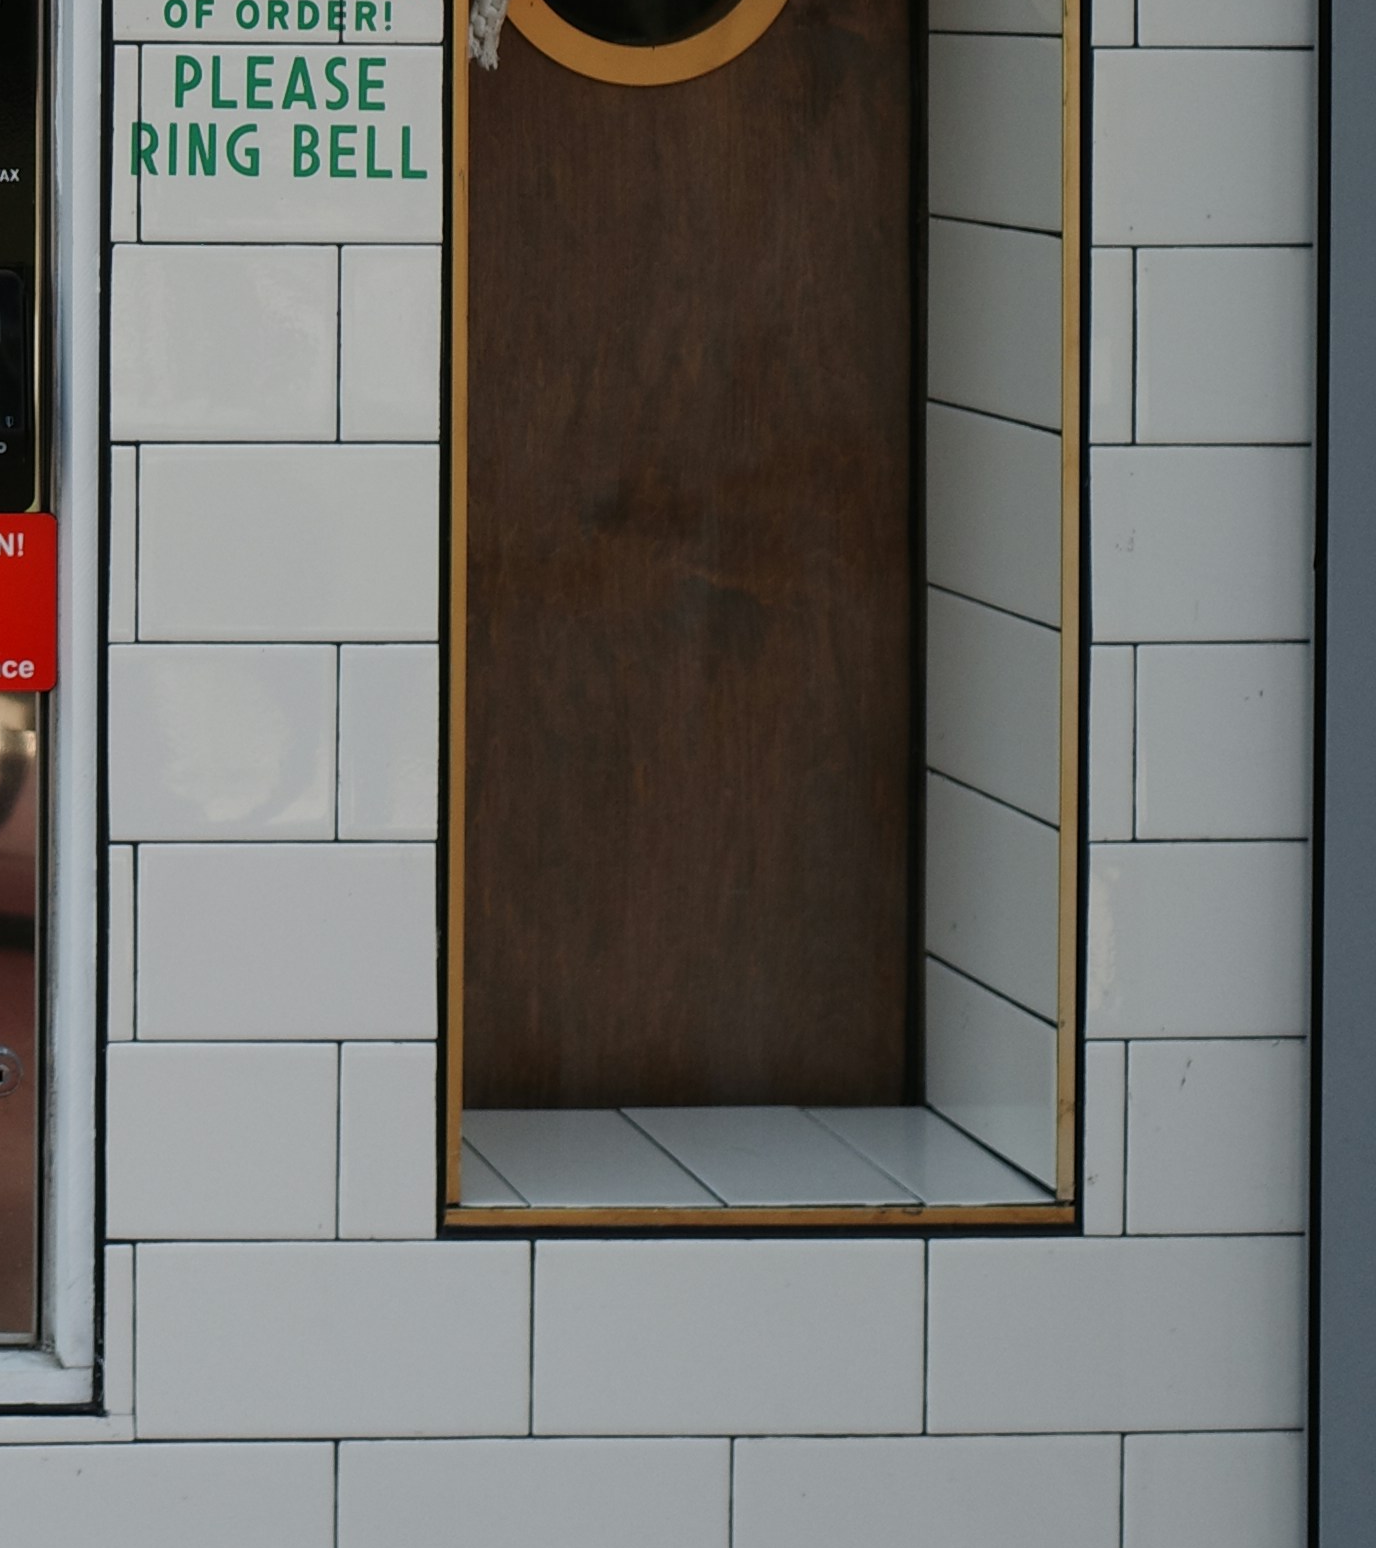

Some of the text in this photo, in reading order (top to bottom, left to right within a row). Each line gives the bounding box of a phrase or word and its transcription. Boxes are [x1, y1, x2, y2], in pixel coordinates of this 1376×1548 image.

[163, 0, 393, 35] OF ORDER!
[175, 55, 386, 110] PLEASE
[130, 121, 427, 179] RING BELL
